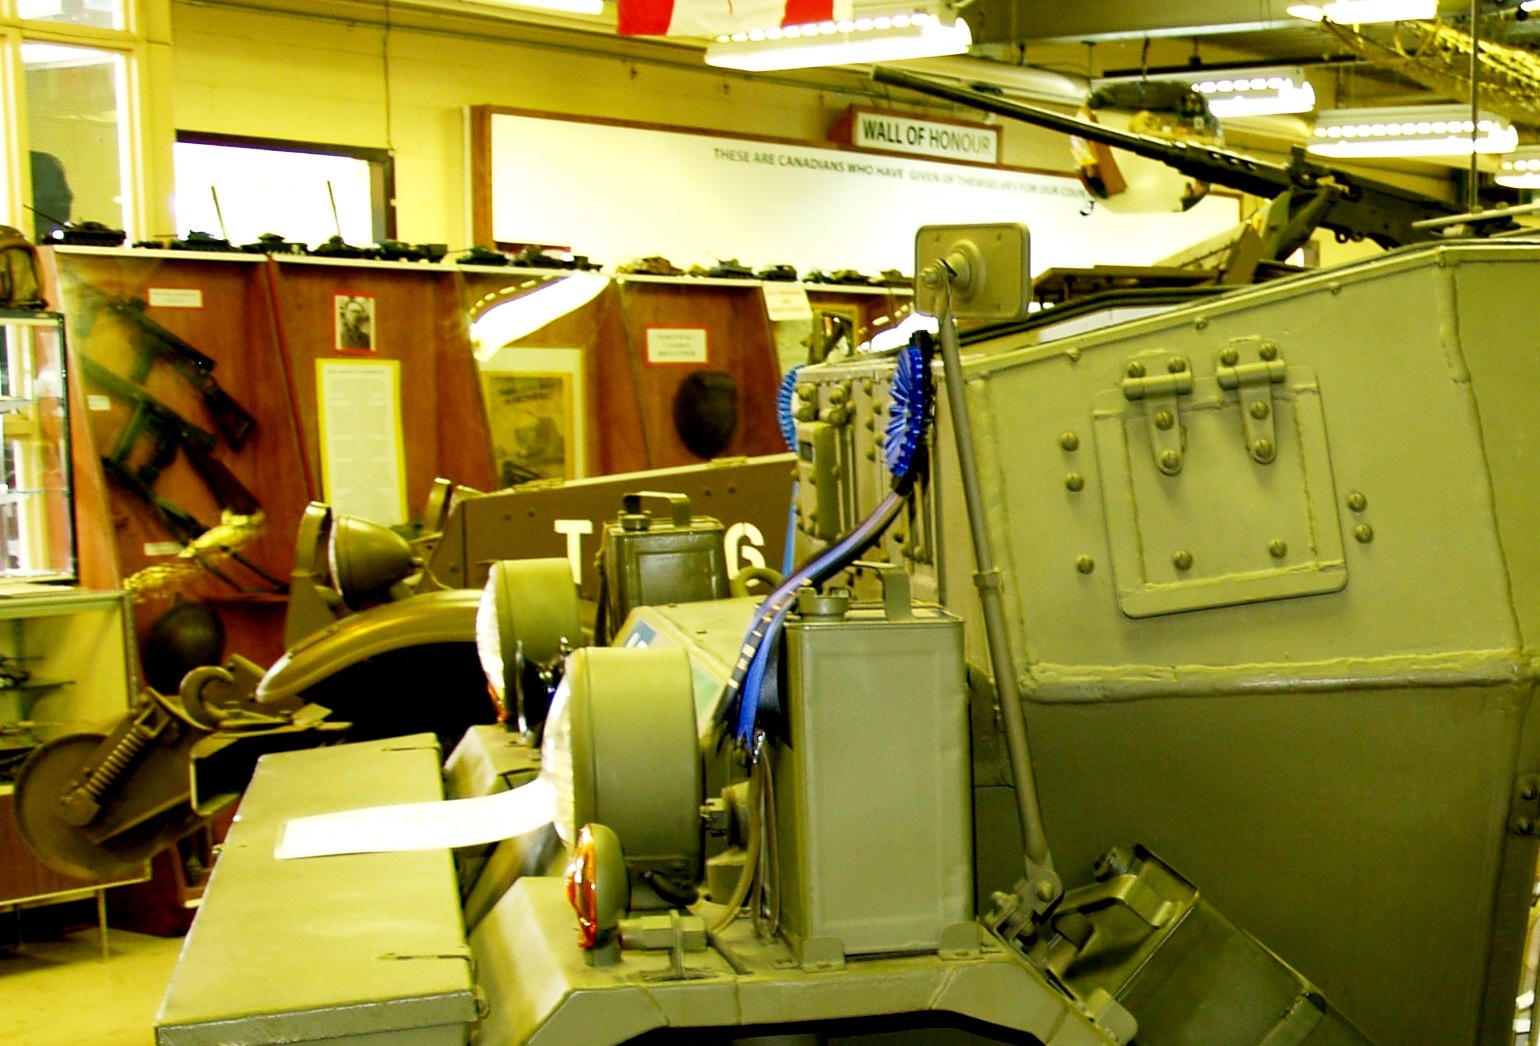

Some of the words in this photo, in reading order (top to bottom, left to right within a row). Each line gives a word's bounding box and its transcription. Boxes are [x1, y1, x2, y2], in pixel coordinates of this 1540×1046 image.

[862, 118, 903, 145] WALL
[906, 125, 925, 147] OF
[929, 129, 991, 154] HONOUR
[713, 147, 750, 163] THESE
[753, 151, 775, 166] ARE
[777, 154, 845, 173] CANADIANS
[847, 162, 874, 176] WHO
[876, 167, 904, 180] HAVE
[908, 169, 940, 183] GIVEN
[942, 173, 955, 184] OF
[957, 175, 1018, 192] THEMSELVES
[1019, 181, 1038, 194] FOR
[1039, 184, 1059, 196] OUR
